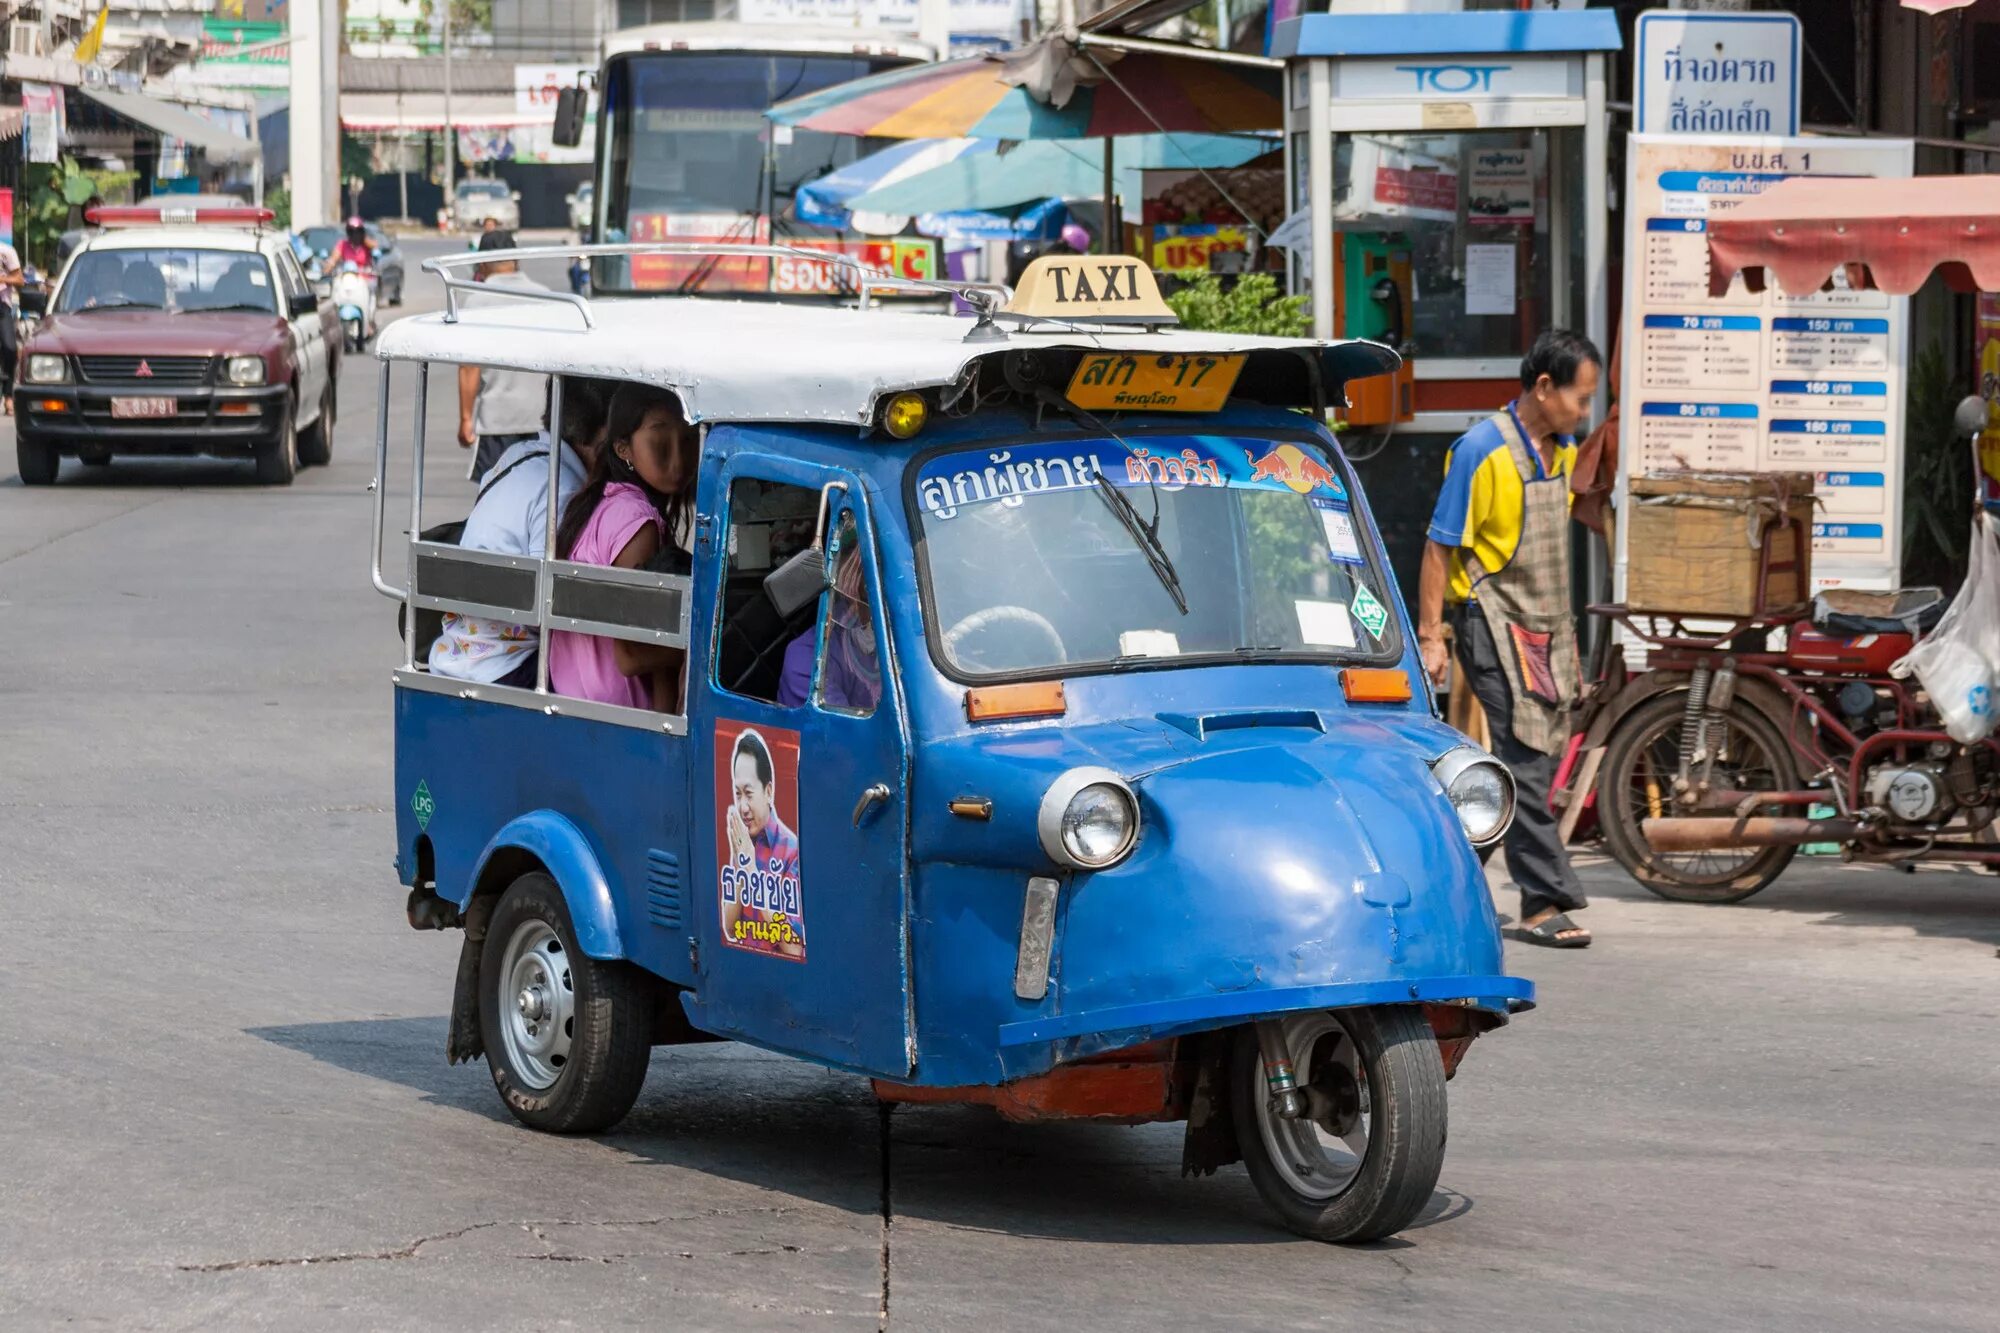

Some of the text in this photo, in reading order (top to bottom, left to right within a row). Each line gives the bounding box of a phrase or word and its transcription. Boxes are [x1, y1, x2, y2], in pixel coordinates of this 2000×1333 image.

[1663, 44, 1776, 83] ที่จอดรถ
[1395, 64, 1513, 92] TOT
[1670, 96, 1772, 132] สี่ล้อเล็ก
[1731, 152, 1812, 170] บ.ข.ส. 1
[1046, 264, 1141, 303] TAXI
[1682, 316, 1699, 329] 70
[1807, 318, 1831, 332] 150
[1082, 356, 1217, 388] สก 17
[1113, 386, 1177, 409] พิษณุโลก
[920, 447, 1225, 521] ลูกผู้ชาย ตัวจริง
[1356, 602, 1383, 619] LPG
[414, 796, 432, 813] LPG
[720, 853, 801, 916] ธวัชชัย
